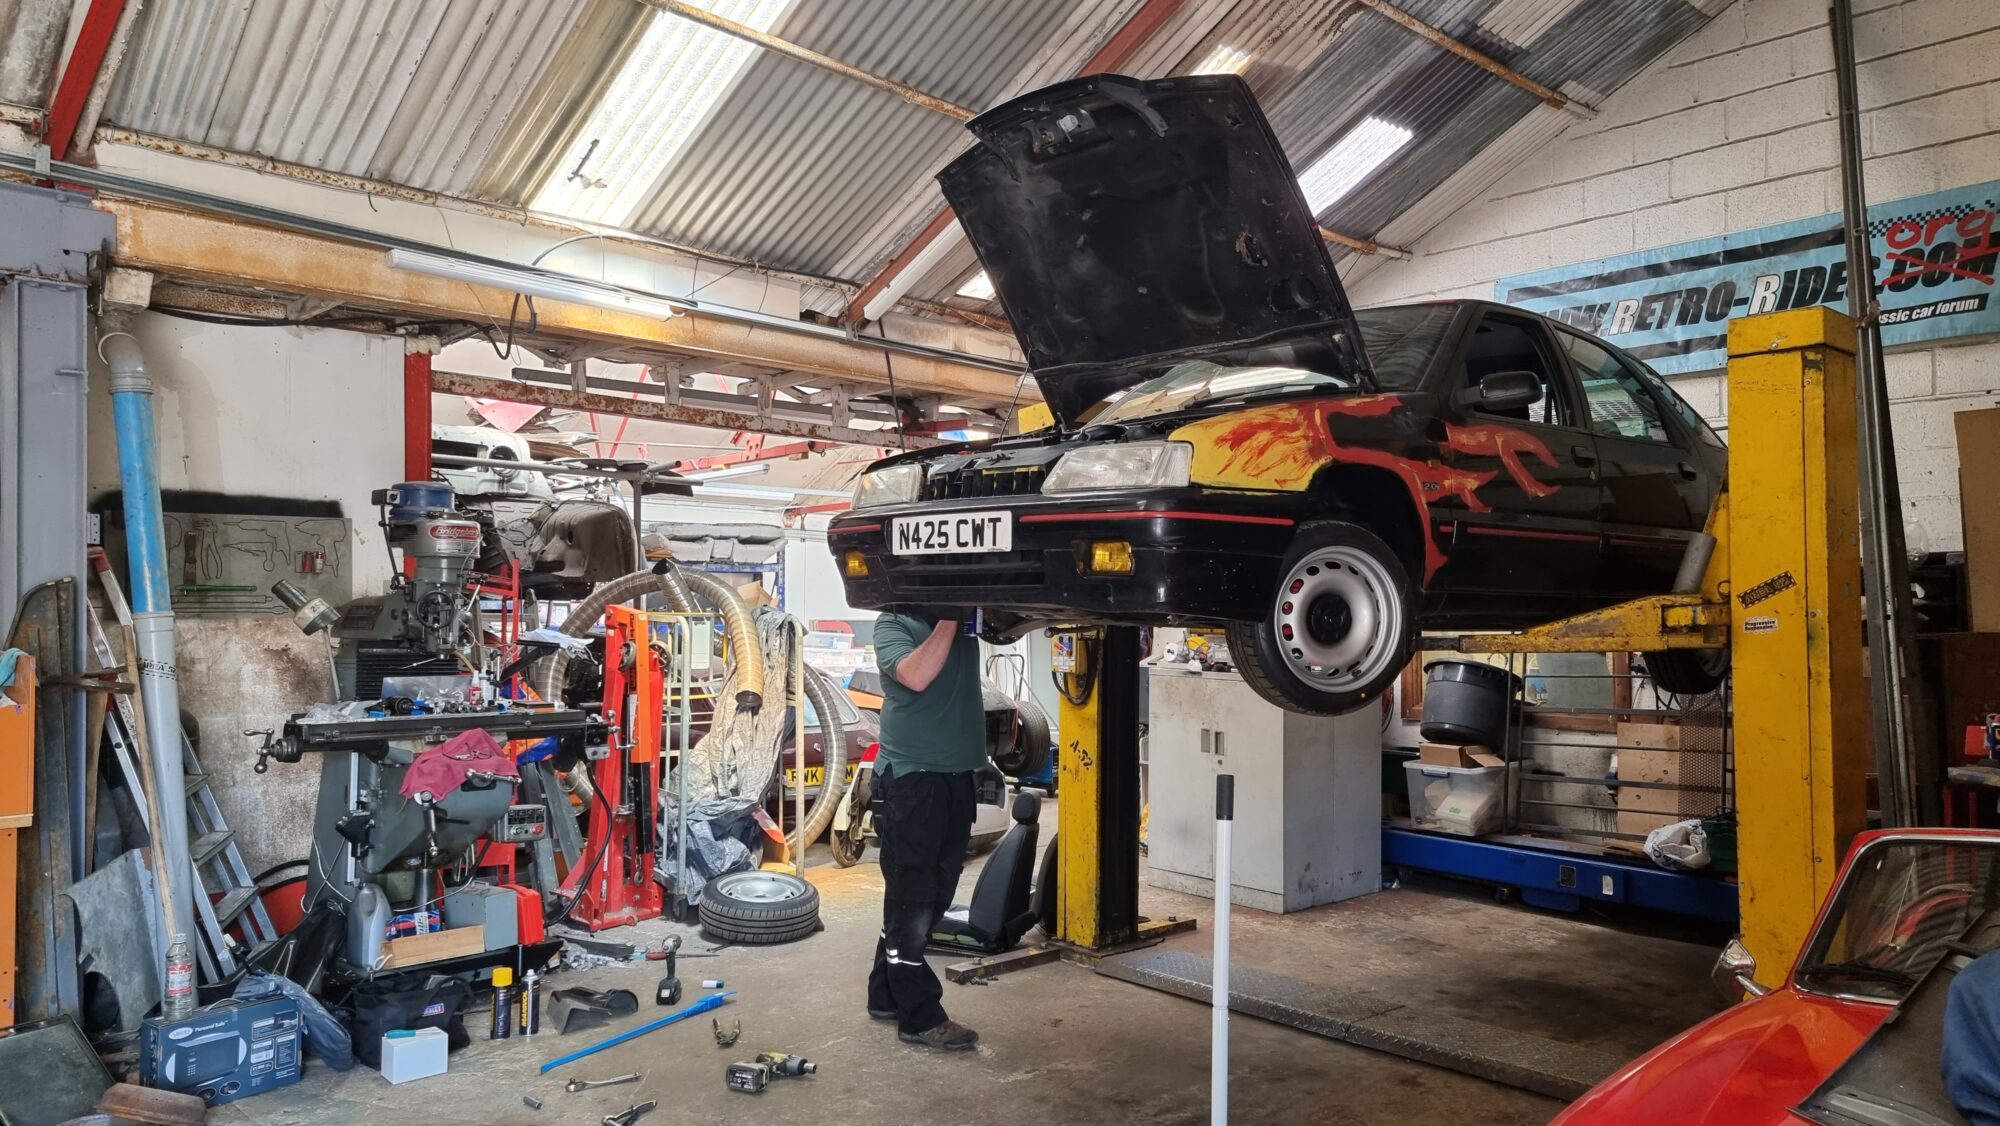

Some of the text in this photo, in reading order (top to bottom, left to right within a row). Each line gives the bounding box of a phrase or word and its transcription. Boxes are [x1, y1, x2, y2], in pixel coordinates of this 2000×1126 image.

[1886, 209, 1996, 257] org
[1879, 299, 1979, 324] ssic car forum
[899, 517, 1002, 550] N425 CWT
